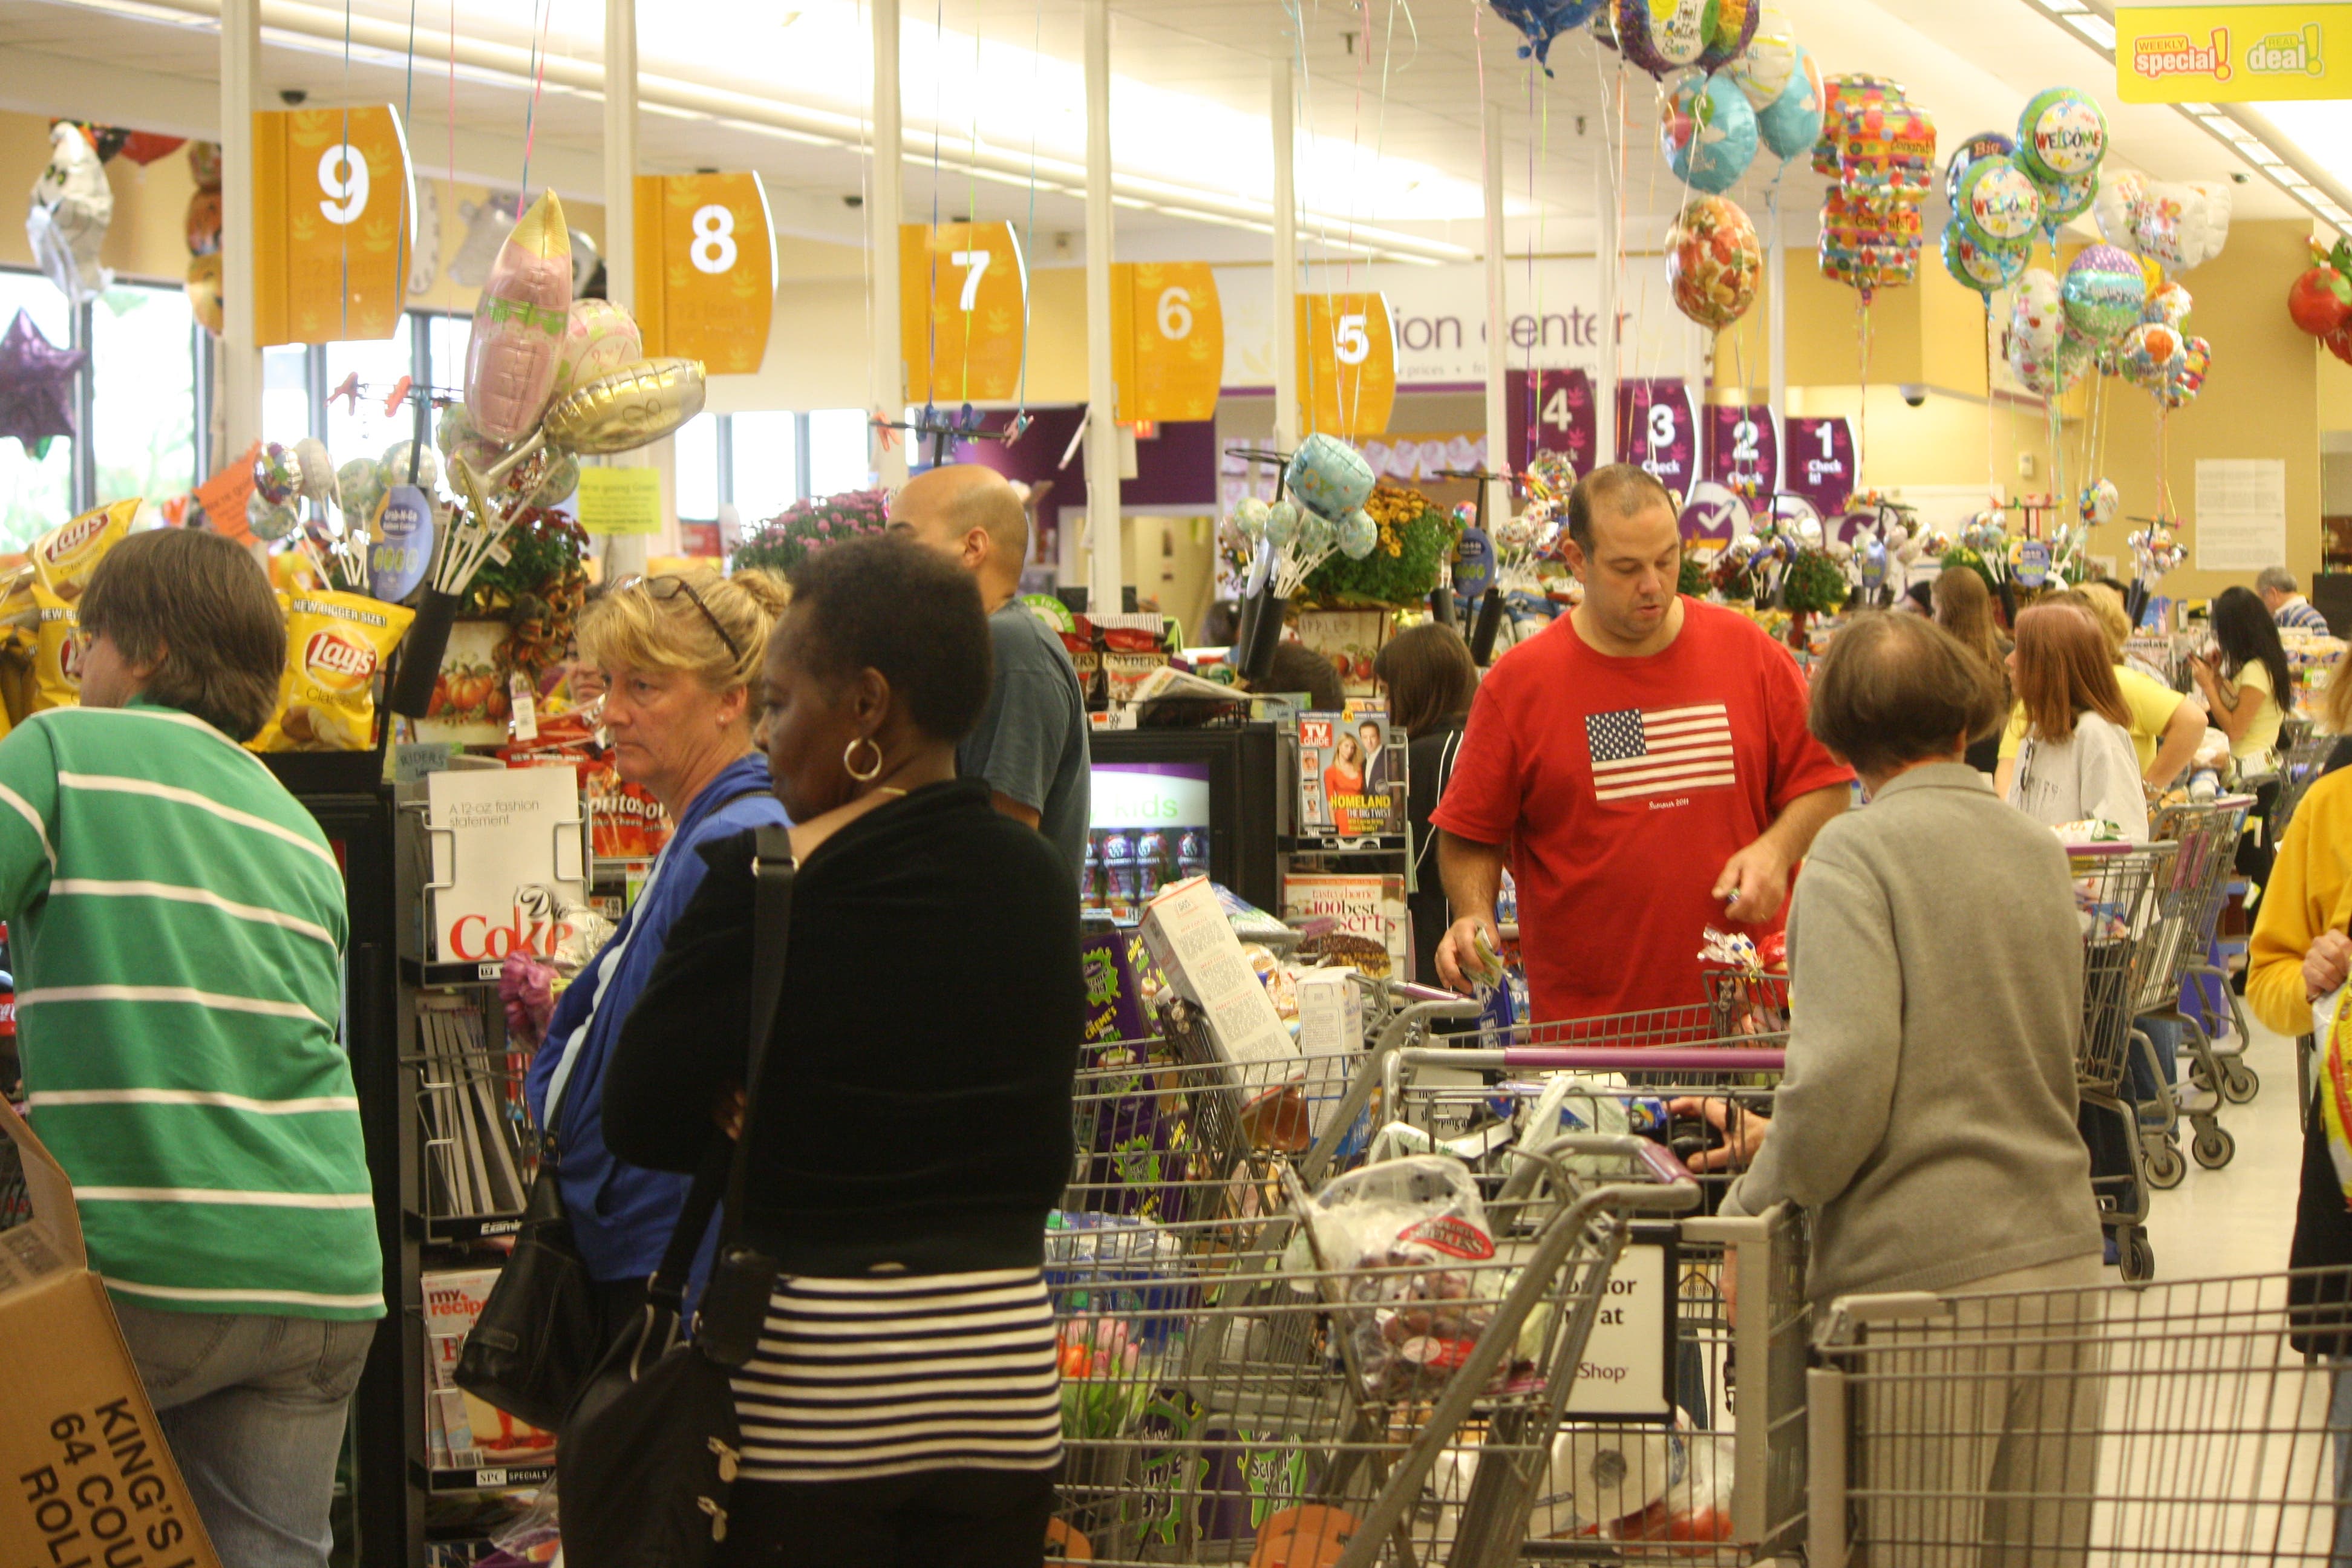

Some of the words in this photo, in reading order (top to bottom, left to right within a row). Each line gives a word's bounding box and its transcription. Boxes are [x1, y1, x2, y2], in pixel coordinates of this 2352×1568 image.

[2139, 39, 2184, 51] WEEKLY
[2269, 37, 2296, 47] REAL
[2035, 127, 2103, 150] WELCOME
[318, 144, 370, 224] 9
[690, 204, 737, 274] 8
[951, 250, 990, 312] 7
[1157, 287, 1193, 340] 6
[1481, 305, 1632, 348] entr
[1336, 315, 1370, 364] 5
[1542, 388, 1573, 433] 4
[1648, 403, 1676, 447] 3
[1732, 420, 1759, 460] 2
[1815, 421, 1833, 459] 1
[1808, 459, 1843, 474] Check
[293, 599, 318, 614] NEW
[319, 604, 359, 621] BIGGER
[1304, 724, 1328, 737] TV
[1304, 737, 1330, 746] GUIDE
[449, 803, 457, 814] A
[496, 799, 540, 813] fashion
[1115, 794, 1178, 818] kids
[1331, 794, 1391, 809] HOMELAND
[1347, 808, 1357, 817] THE
[1358, 808, 1370, 817] BIG
[449, 814, 509, 828] statement
[520, 885, 569, 920] Die
[1313, 900, 1341, 915] 100
[1342, 900, 1376, 915] best
[1339, 914, 1396, 932] serts
[449, 913, 575, 961] Coke
[430, 1289, 460, 1303] my
[1600, 1307, 1625, 1324] at
[1578, 1362, 1627, 1384] Shop
[50, 1413, 97, 1466] 64
[94, 1396, 184, 1552] KING'S
[509, 1470, 547, 1481] SPECIALS
